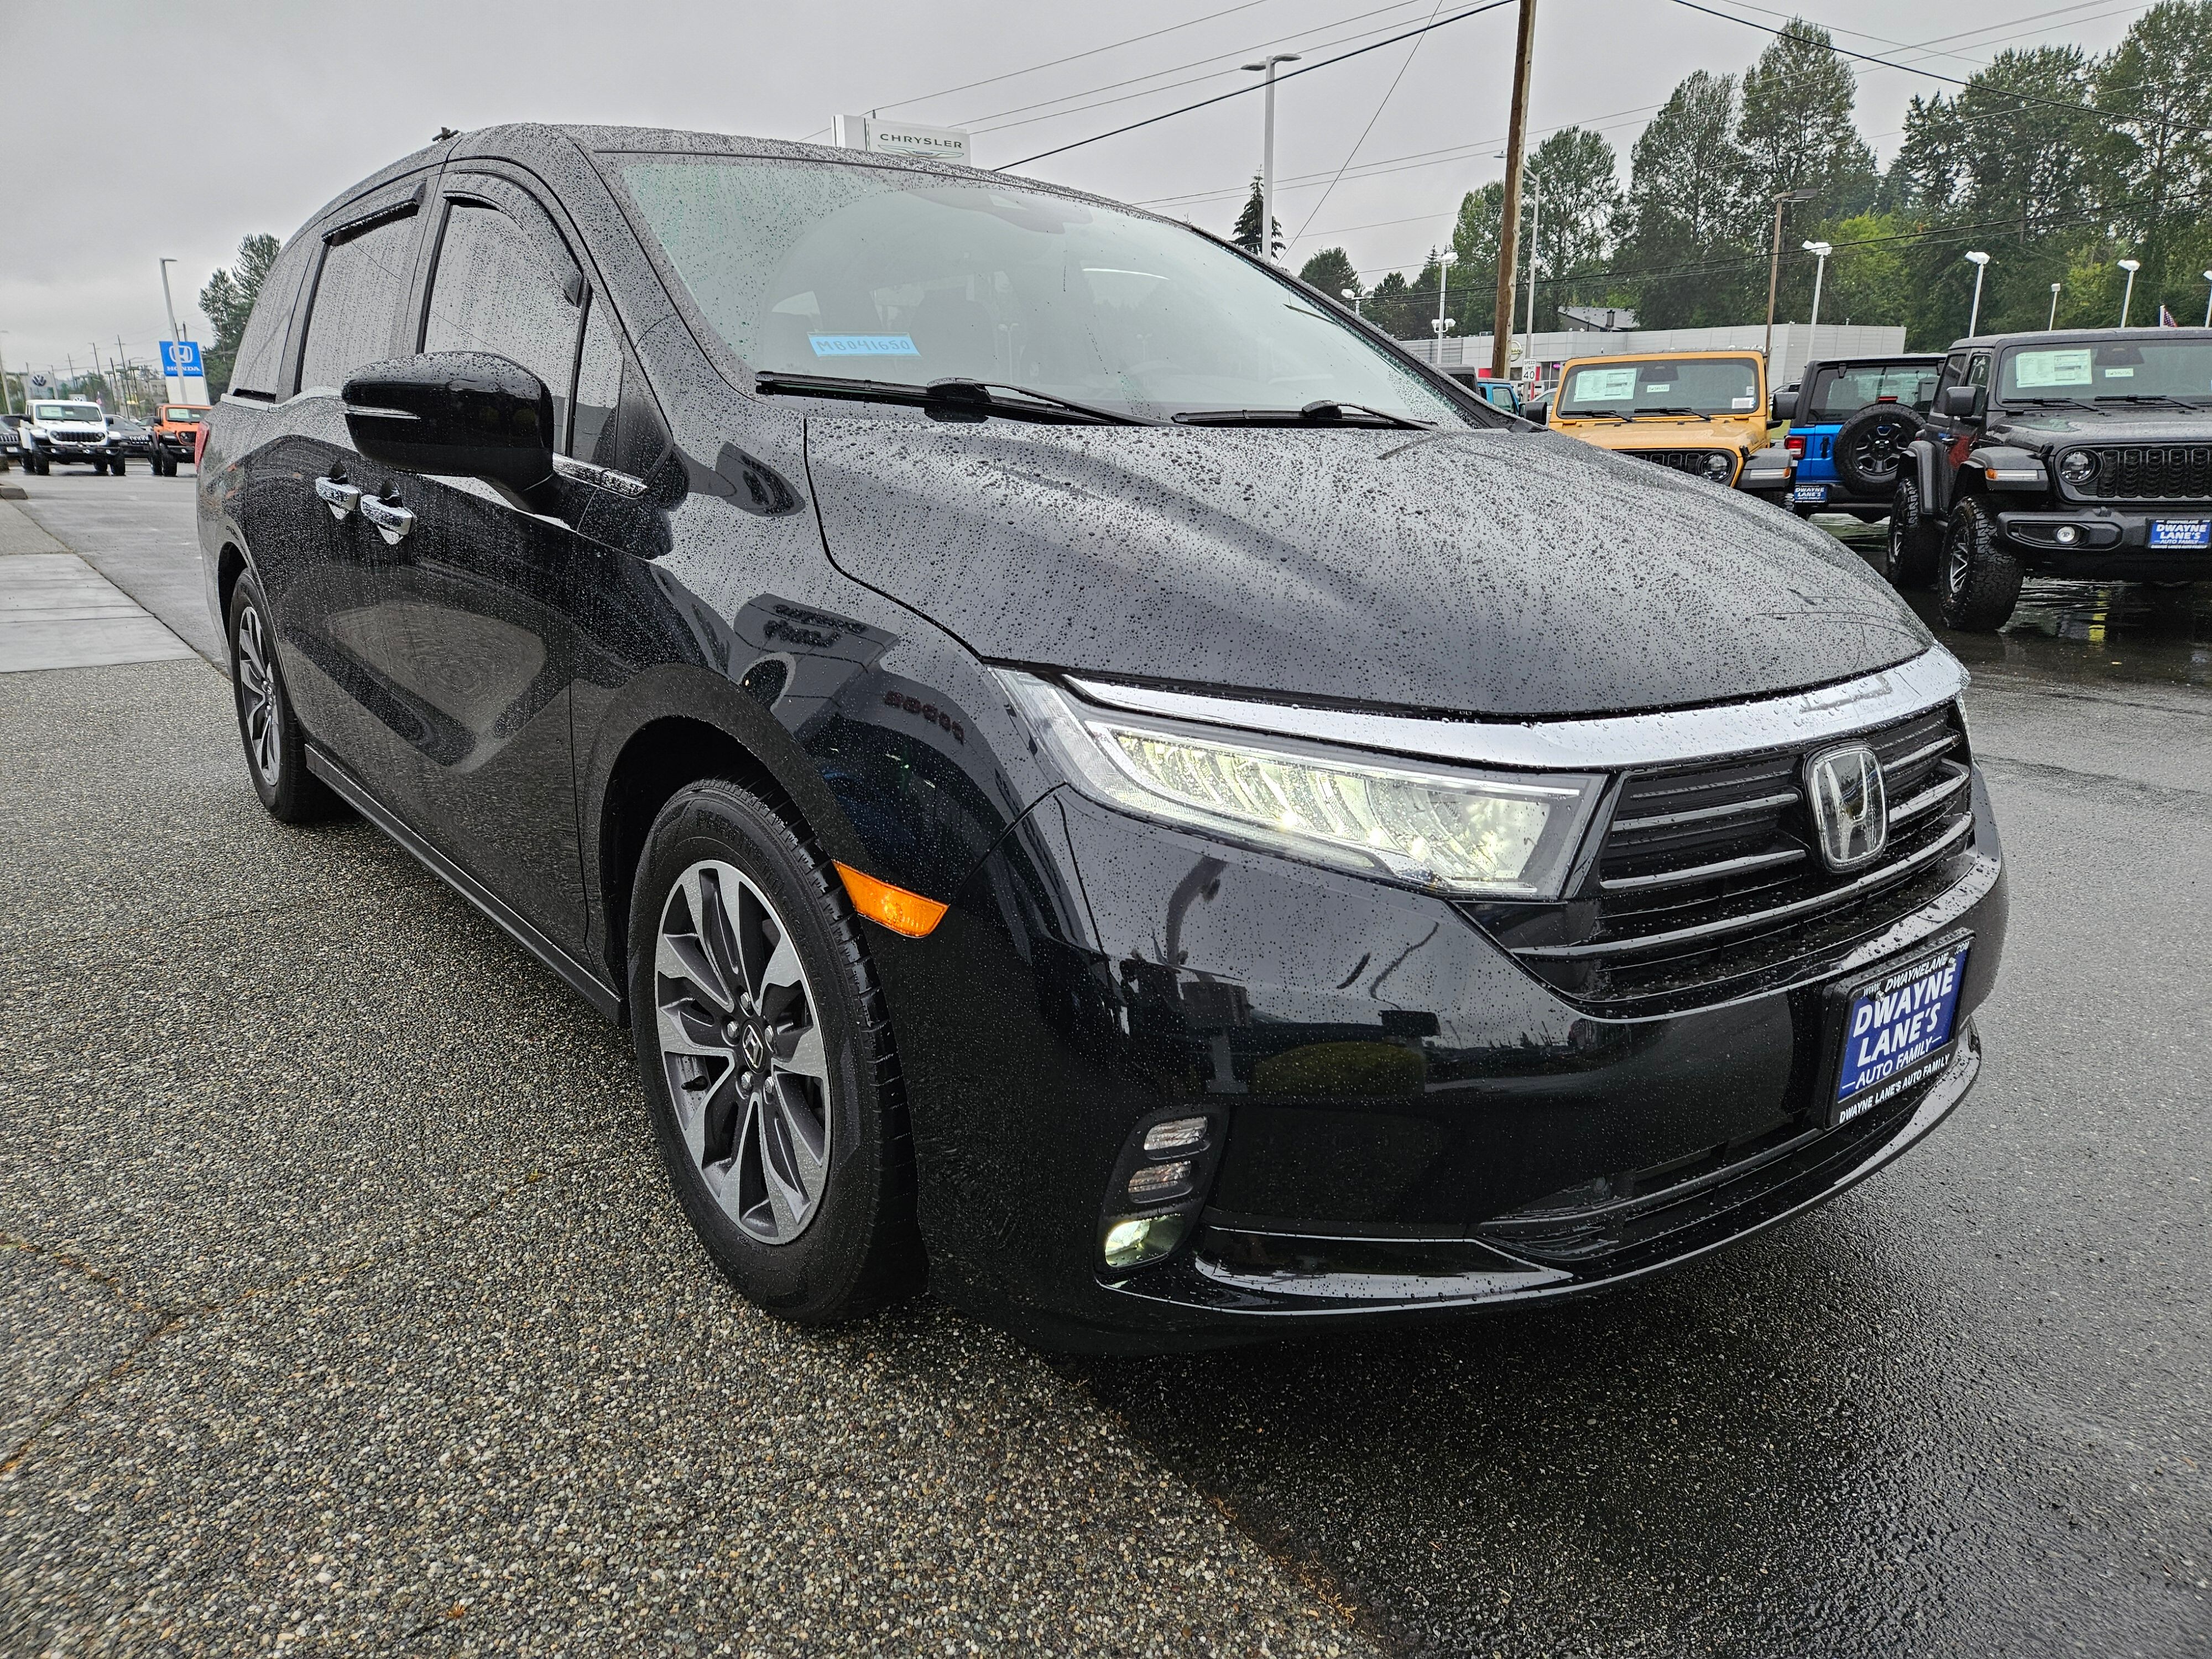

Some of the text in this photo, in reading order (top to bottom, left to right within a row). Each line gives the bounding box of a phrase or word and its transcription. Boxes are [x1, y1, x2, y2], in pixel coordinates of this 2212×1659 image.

[880, 133, 962, 149] CHRYSLER
[1885, 952, 1949, 993] DWAYNELANE
[1853, 967, 1957, 1038] DWAYNE
[1855, 1036, 1933, 1089] AUTO FAMILY
[1858, 1002, 1941, 1068] LANE'S
[1839, 1053, 1950, 1124] DWAYNE LANE'S AUTO FAMILY
